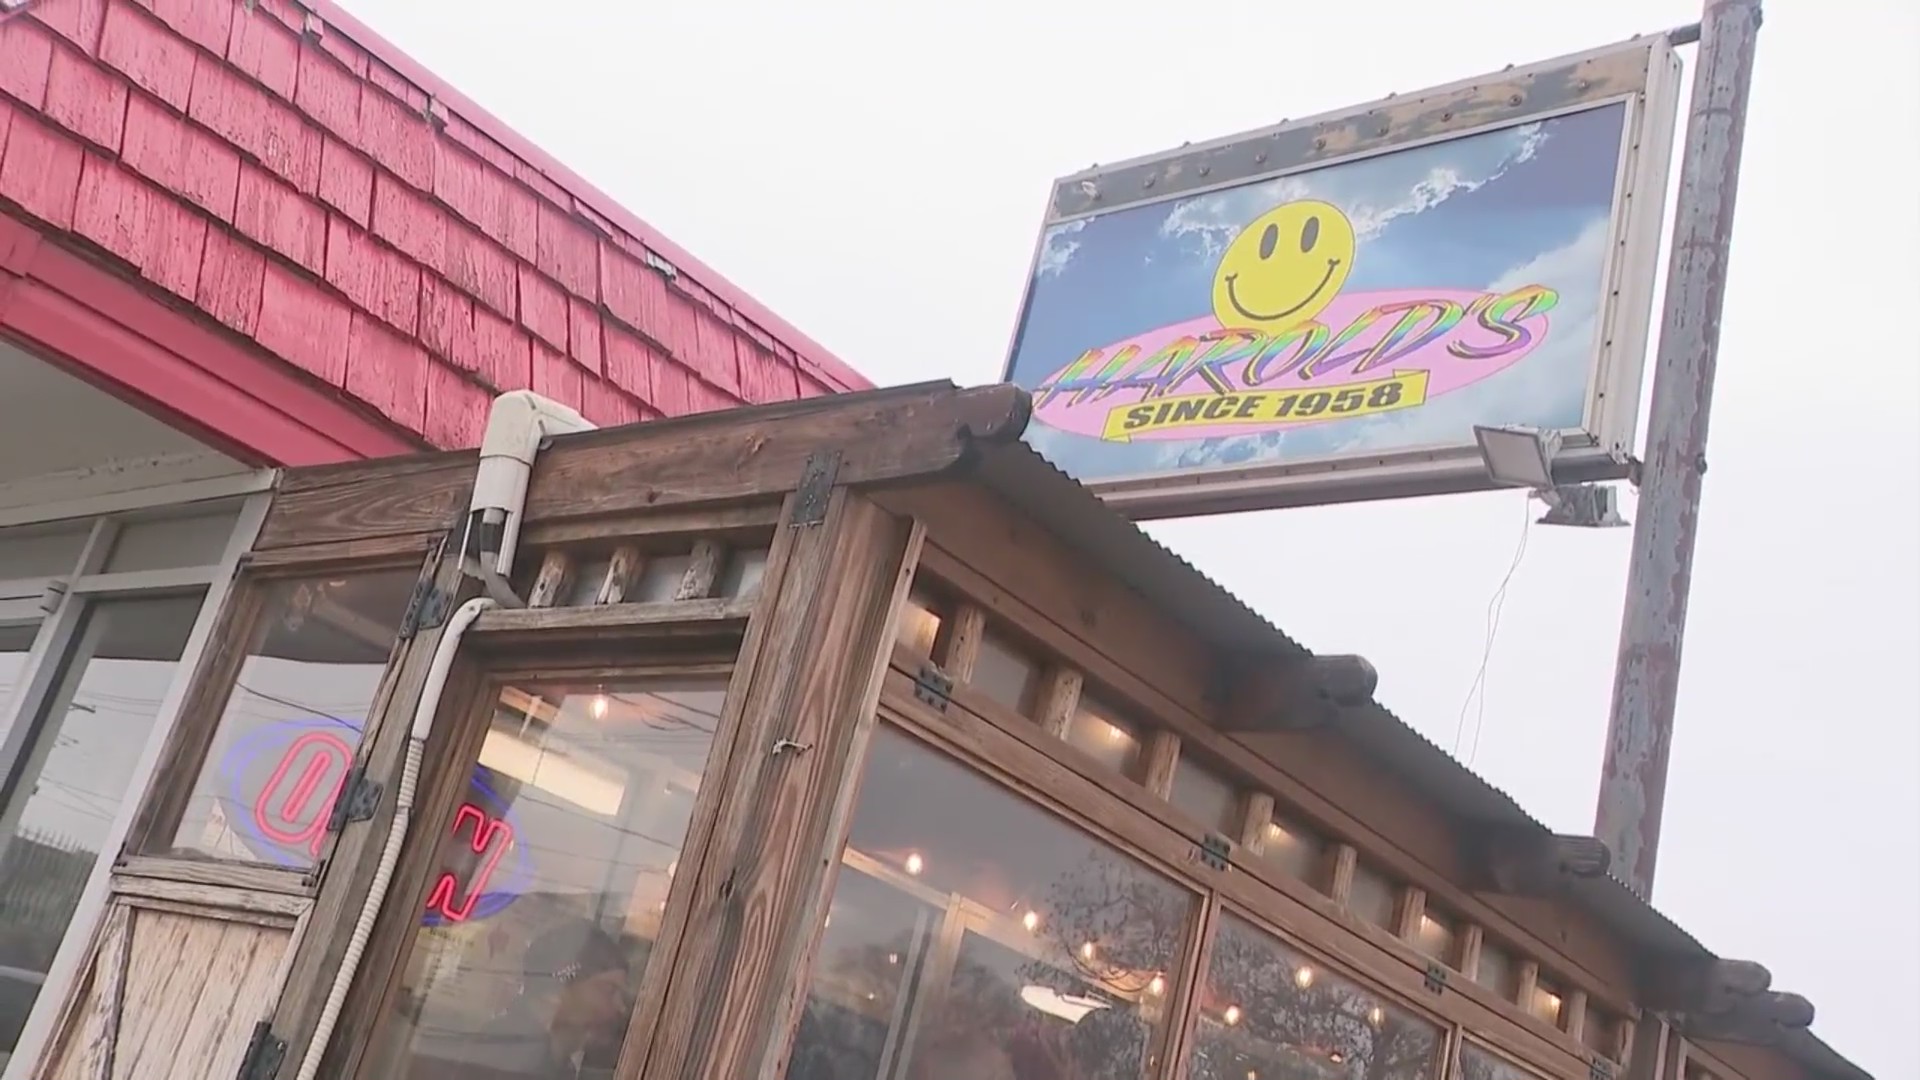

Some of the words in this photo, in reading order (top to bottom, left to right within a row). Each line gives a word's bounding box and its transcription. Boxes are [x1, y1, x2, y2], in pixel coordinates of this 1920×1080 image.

[1031, 284, 1559, 408] HAROLD'S
[1123, 395, 1268, 430] SINCE
[1275, 381, 1404, 418] 1958
